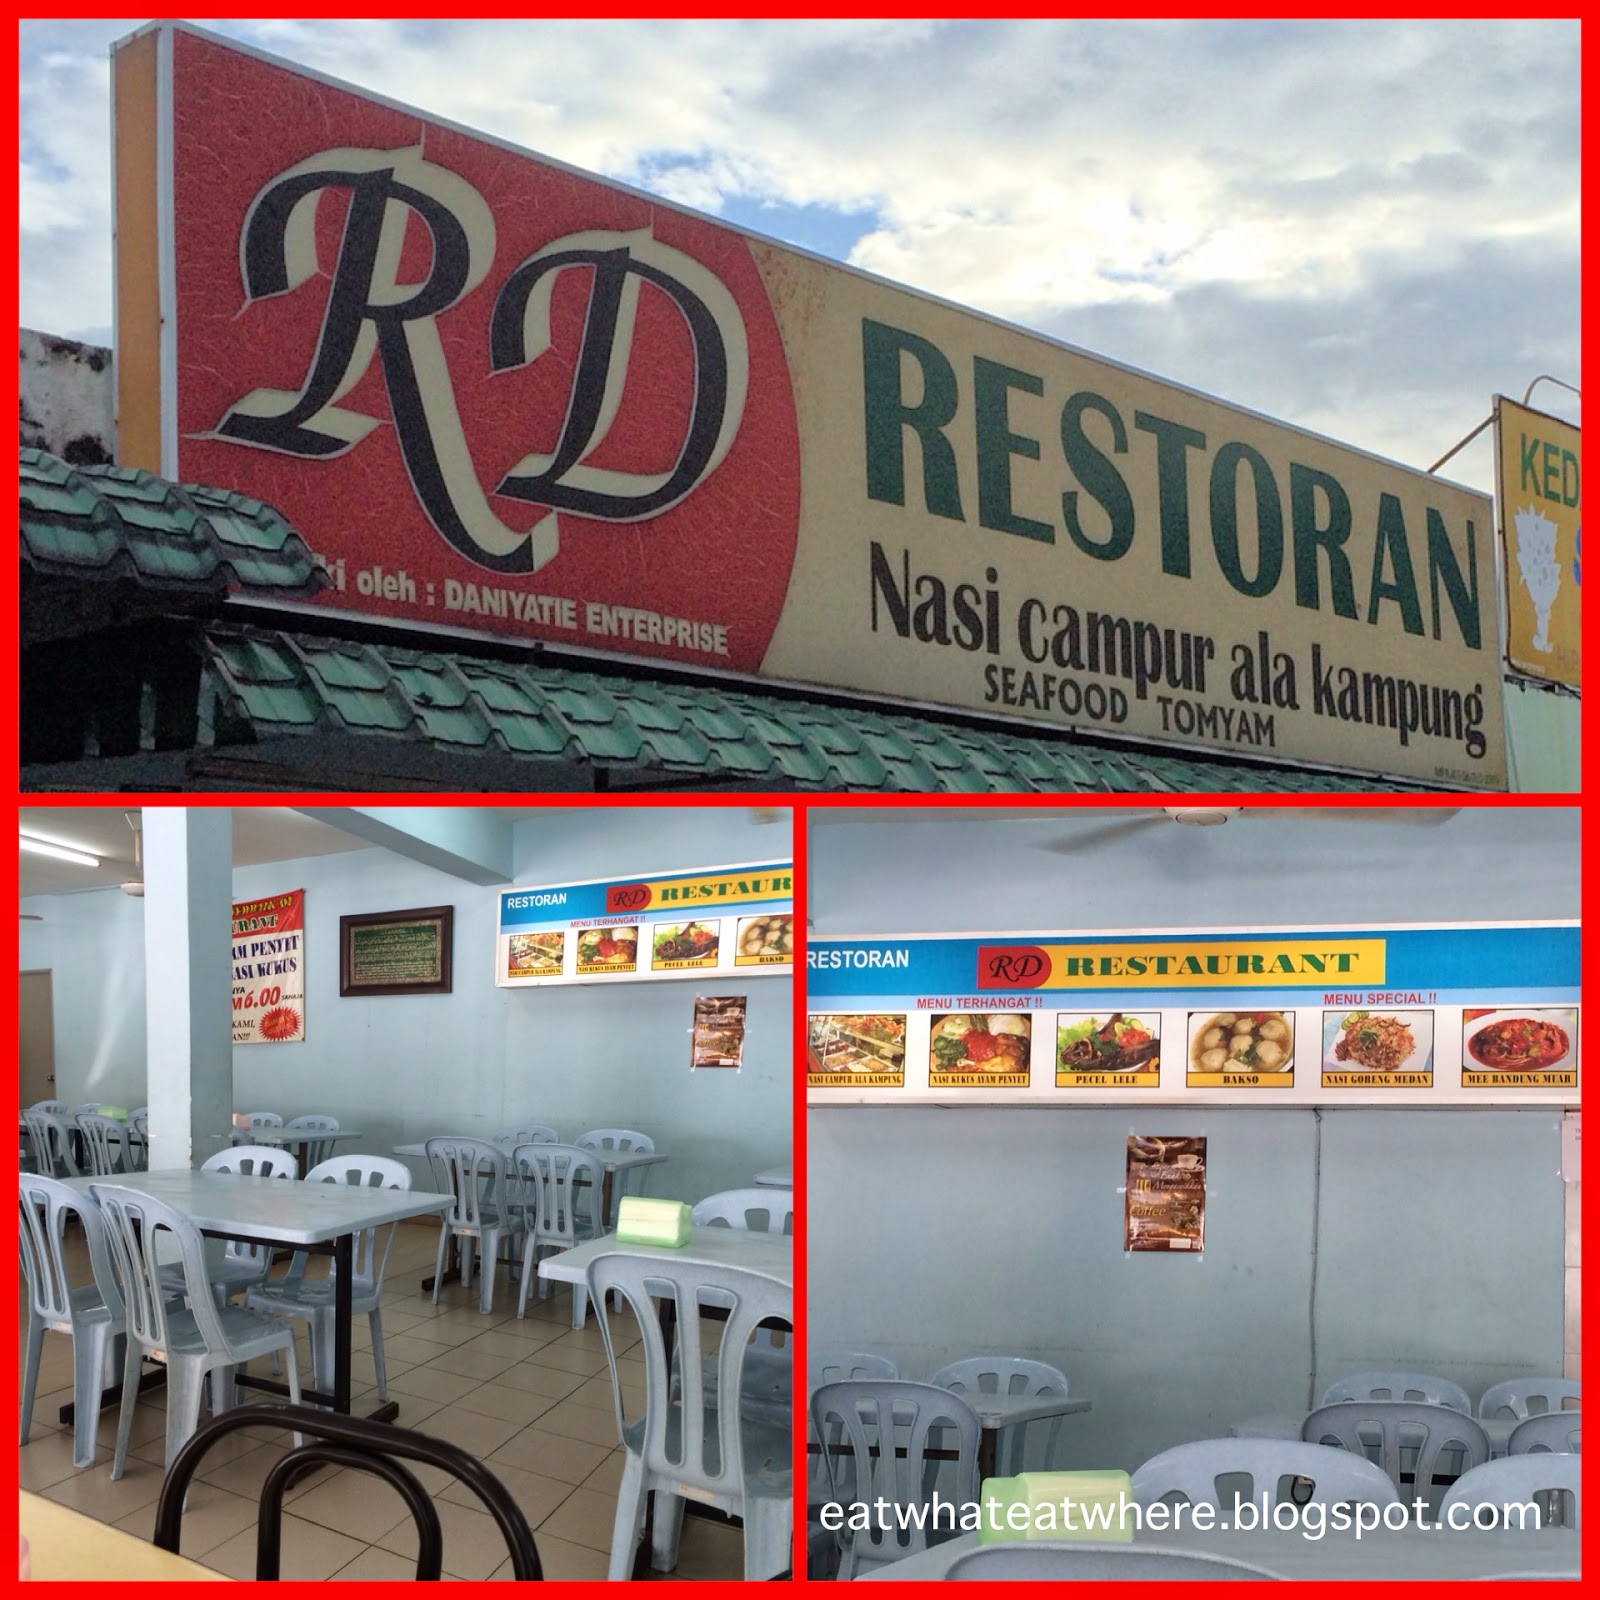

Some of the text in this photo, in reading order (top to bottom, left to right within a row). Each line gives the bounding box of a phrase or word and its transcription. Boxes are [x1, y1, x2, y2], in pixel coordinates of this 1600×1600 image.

[216, 145, 750, 575] RD
[1520, 433, 1581, 508] KED
[861, 318, 1482, 650] RESTORAN
[357, 565, 417, 604] oleh
[444, 578, 577, 631] DANIYATIE
[585, 602, 729, 657] ENTERPRISE
[870, 541, 1487, 759] Nasi campur ala kampung
[984, 664, 1275, 748] SEAFOOD TOMYAM
[507, 877, 792, 909] RESTORAN RD RESTAUR
[570, 920, 591, 928] MENU
[593, 916, 639, 926] TERHANGAT
[251, 935, 299, 957] PENYET
[232, 957, 297, 980] ASI KUKUS
[806, 949, 1360, 982] RESTORAN RD RESTAURANT
[916, 997, 953, 1009] MENU
[956, 997, 1031, 1009] TERHANGAT
[1323, 993, 1364, 1006] MENU
[1366, 993, 1426, 1005] SPECIAL
[808, 1075, 824, 1084] NASI
[854, 1075, 867, 1084] ALA
[868, 1075, 902, 1084] KAMPUNG
[933, 1075, 949, 1084] NASI
[977, 1075, 996, 1084] AYAM
[998, 1075, 1027, 1084] PENYET
[1075, 1075, 1138, 1085] PECEL LELE
[1222, 1075, 1260, 1085] BAKSO
[1325, 1074, 1429, 1085] NASI GORENG MEDAN
[1467, 1074, 1572, 1084] MEE BANDUNG MUAR
[1130, 1204, 1167, 1217] Coffee
